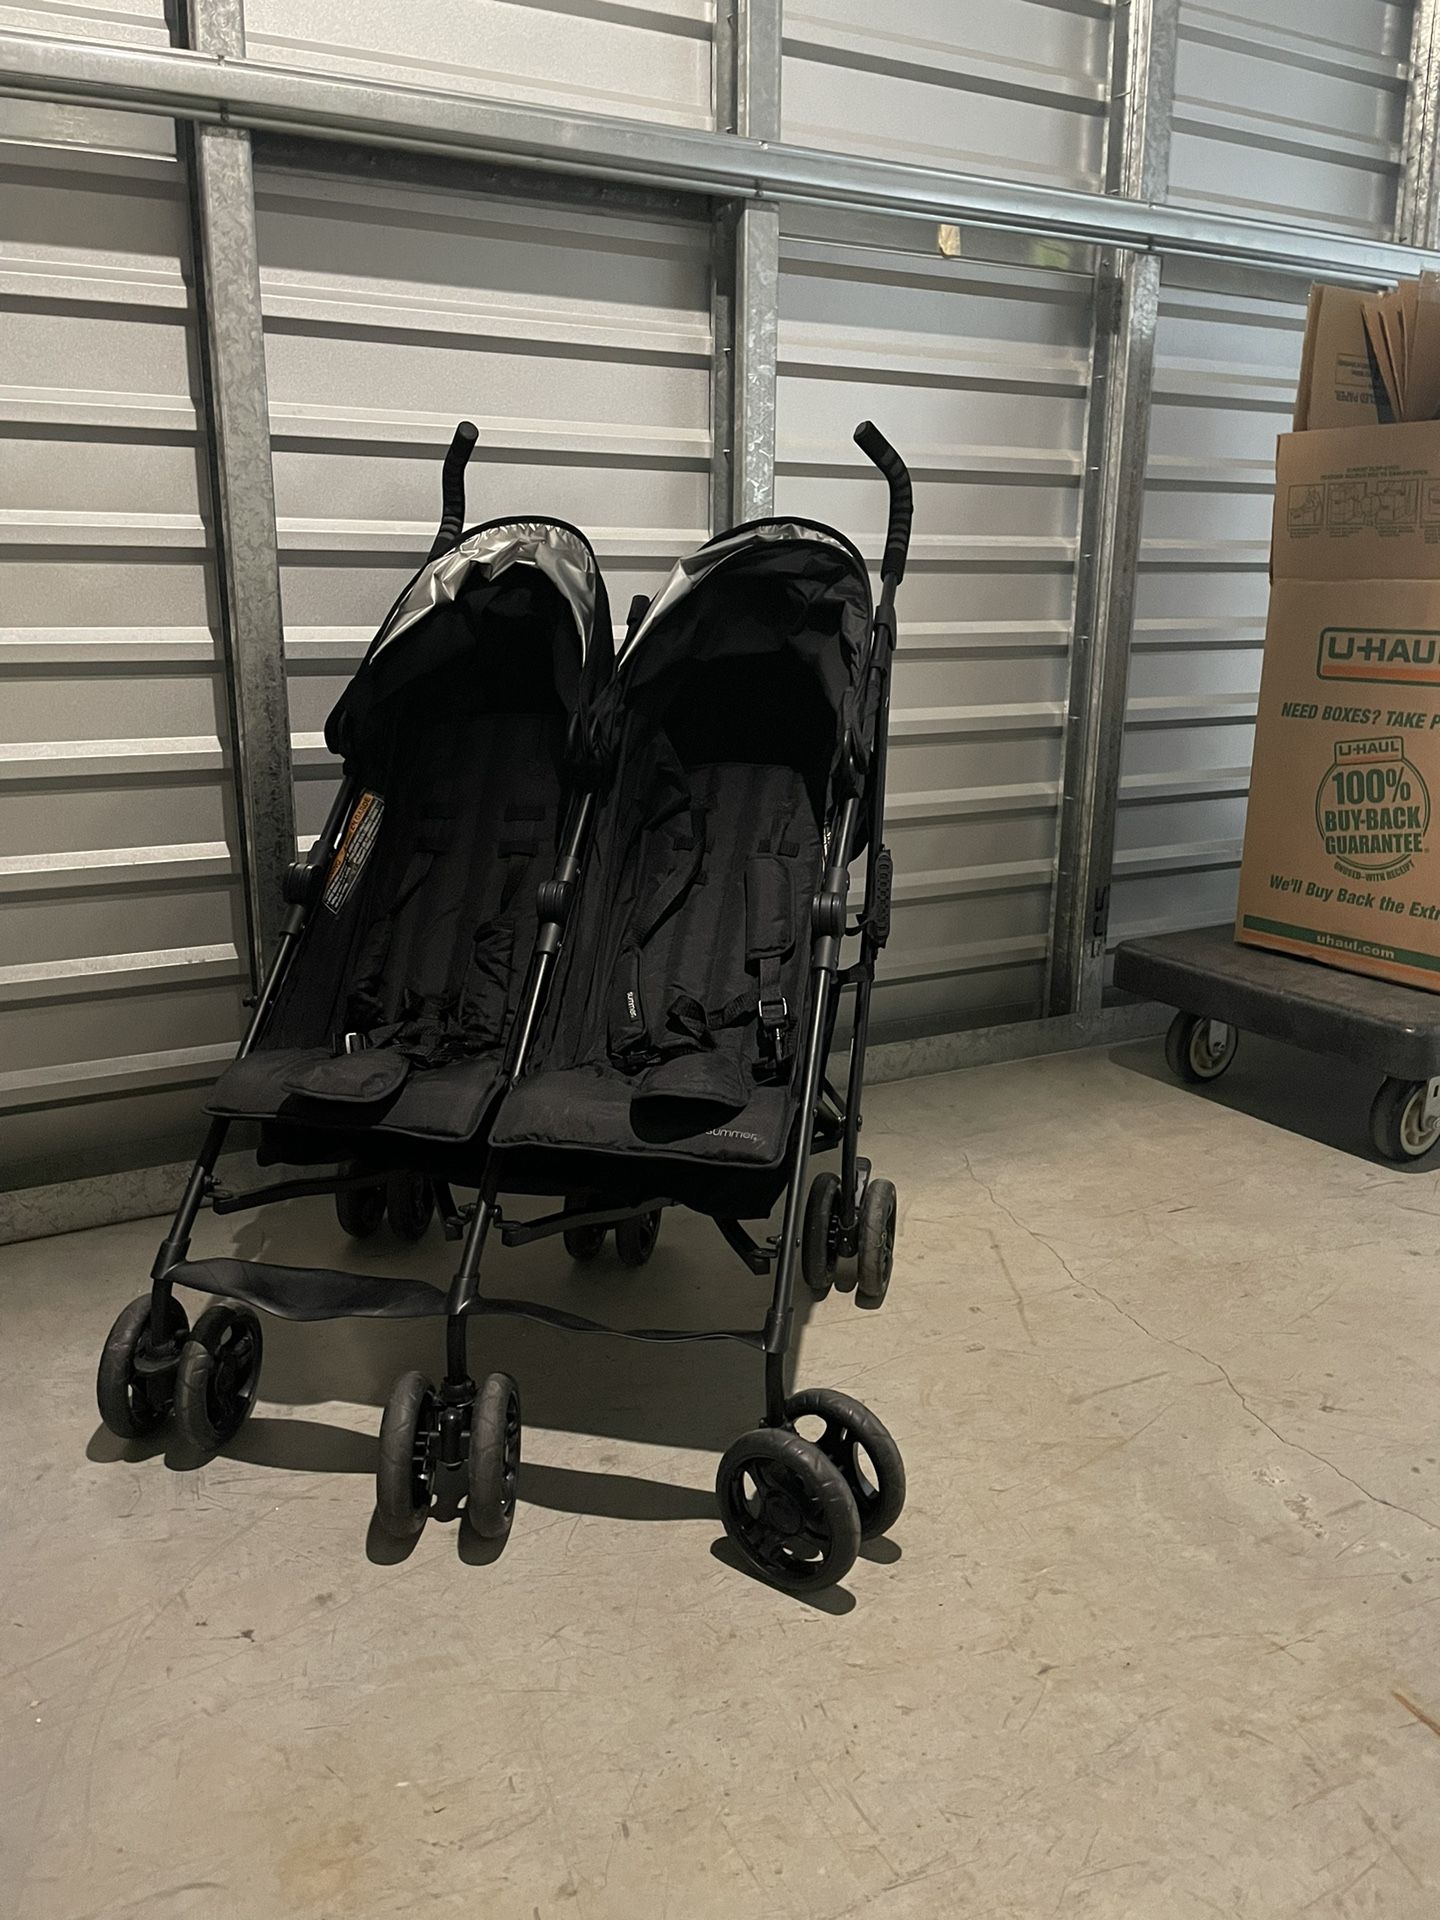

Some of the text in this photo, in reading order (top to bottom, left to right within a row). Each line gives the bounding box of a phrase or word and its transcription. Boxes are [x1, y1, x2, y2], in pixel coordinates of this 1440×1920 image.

[1328, 636, 1440, 663] U-HAU
[1281, 702, 1318, 719] NEED
[1322, 706, 1381, 725] BOXES?
[1386, 710, 1427, 729] TAKE
[1338, 740, 1399, 756] U-HAUL
[1332, 766, 1411, 805] 100%
[1325, 806, 1421, 832] BUY-BACK
[1325, 833, 1423, 855] GUARANTEE
[1386, 859, 1415, 880] RECEIPT
[1269, 874, 1303, 893] We'll
[1305, 882, 1334, 902] Buy
[1336, 888, 1376, 909] Back
[1379, 896, 1405, 914] the
[1316, 934, 1395, 959] uhaul.com
